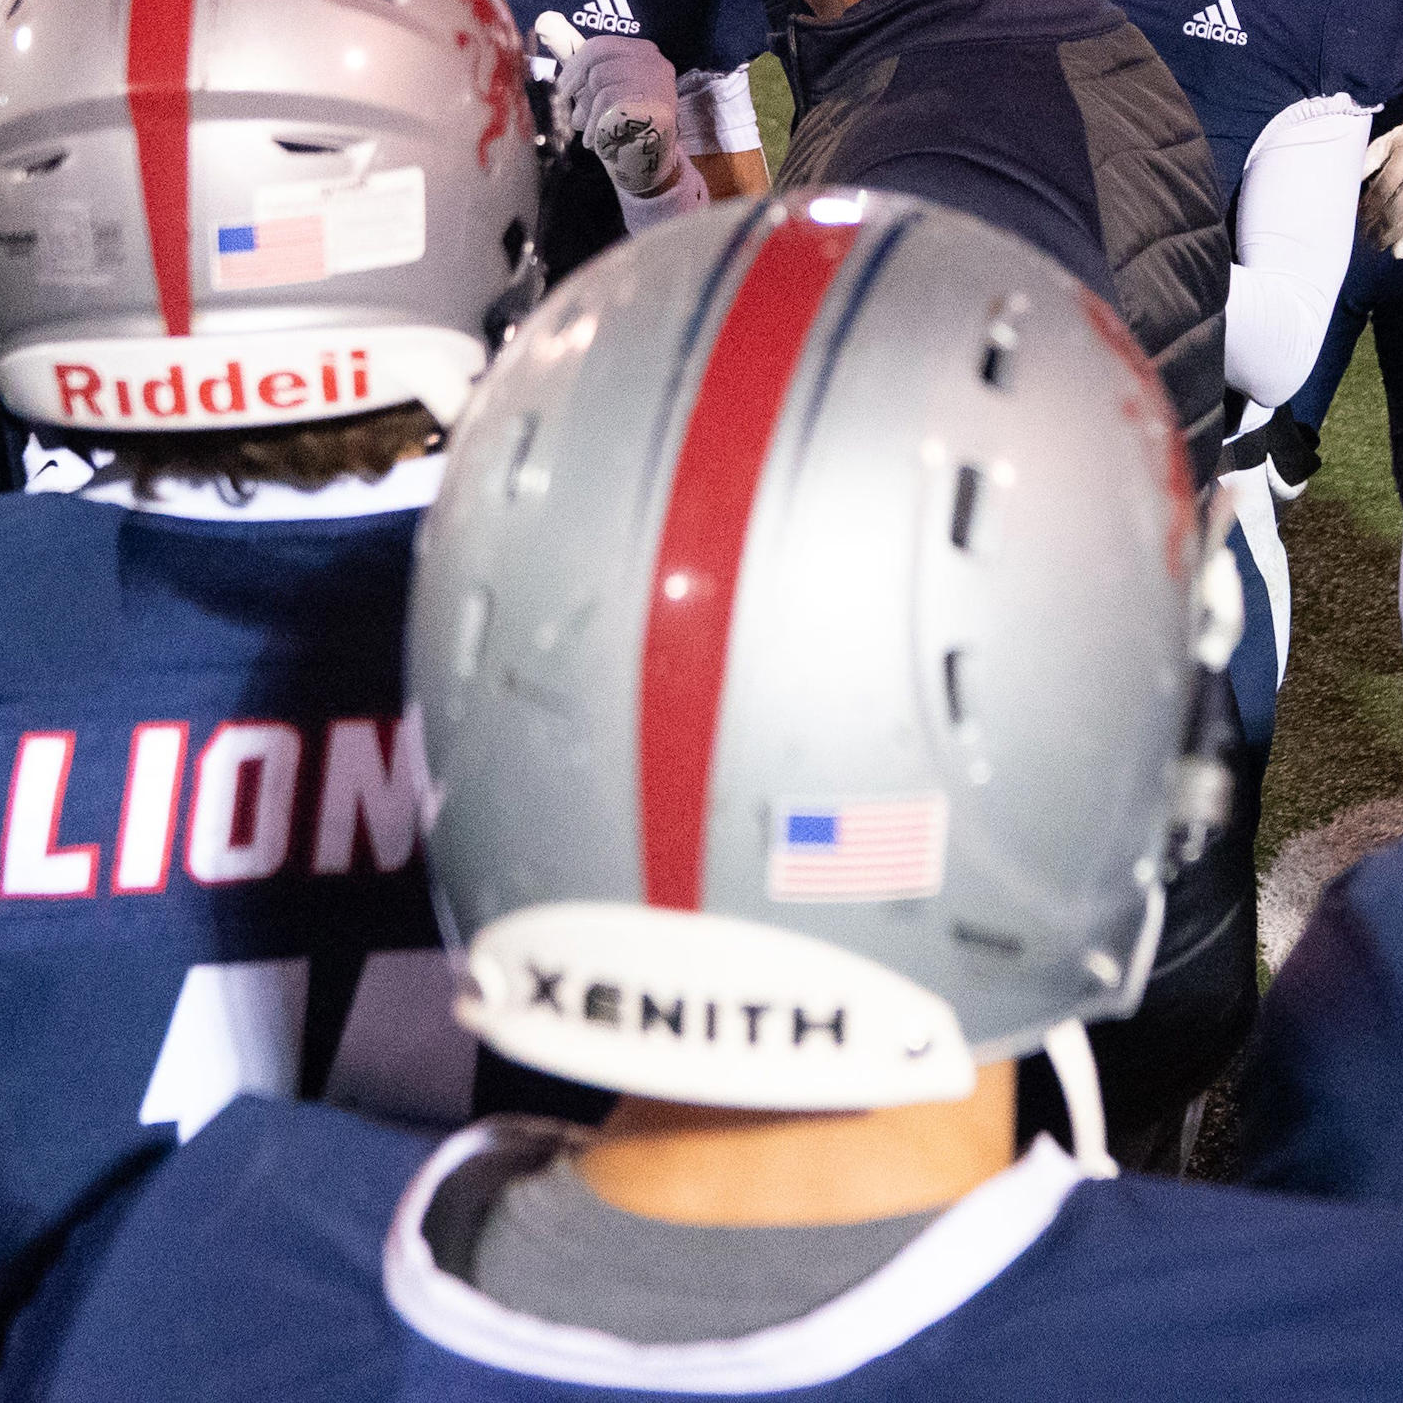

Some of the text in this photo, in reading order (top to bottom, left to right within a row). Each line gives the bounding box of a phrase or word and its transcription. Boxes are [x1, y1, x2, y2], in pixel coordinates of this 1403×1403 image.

[572, 10, 641, 35] adidas
[1182, 20, 1249, 46] adidas
[524, 956, 846, 1048] XENITH
